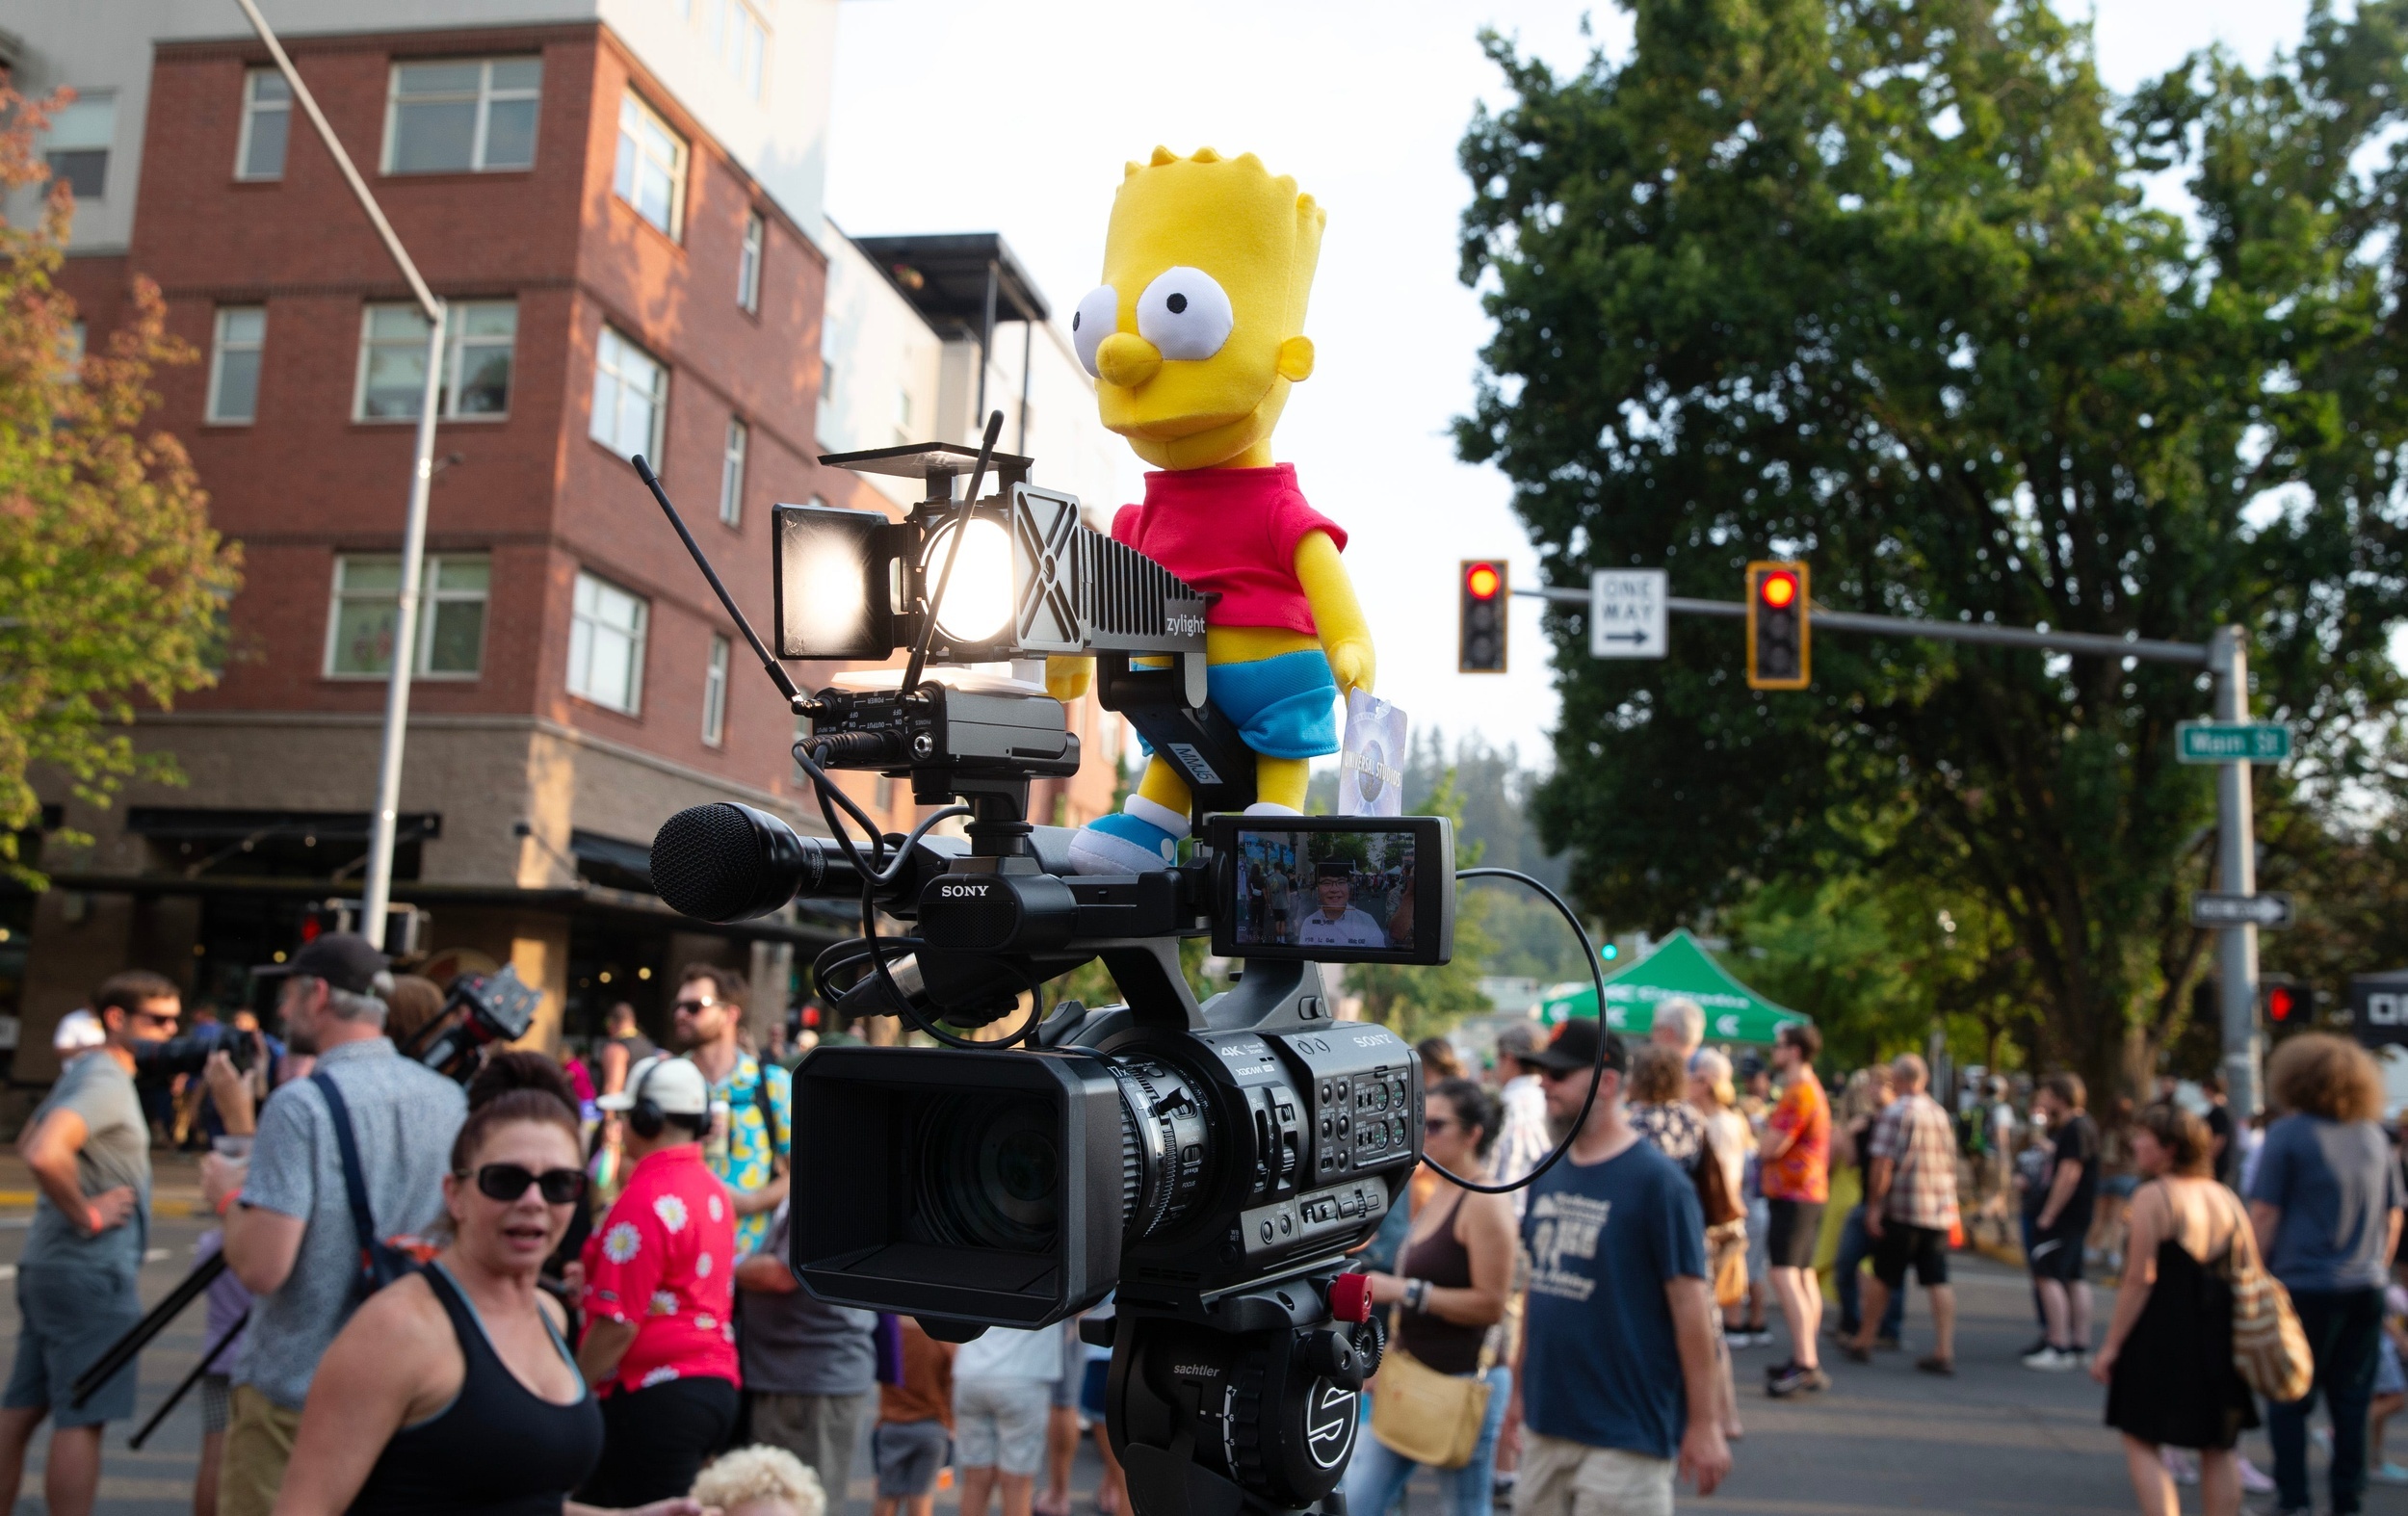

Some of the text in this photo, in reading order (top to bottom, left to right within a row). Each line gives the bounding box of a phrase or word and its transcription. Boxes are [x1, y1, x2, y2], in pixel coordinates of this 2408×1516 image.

[1603, 578, 1654, 599] ONE
[1603, 602, 1655, 622] WAY
[1166, 614, 1206, 637] zylight
[867, 696, 884, 705] POWER
[893, 708, 903, 717] OFF
[2190, 732, 2279, 754] Main St
[1175, 748, 1215, 779] MMJ5
[1345, 751, 1400, 787] UNIVERSAL STUDIOS
[941, 885, 989, 897] SONY
[1352, 1033, 1394, 1047] SONY
[1221, 1045, 1245, 1057] 4K
[1106, 1065, 1130, 1078] 17x
[1235, 1065, 1263, 1077] XDCAM
[1173, 1364, 1219, 1377] sachtler
